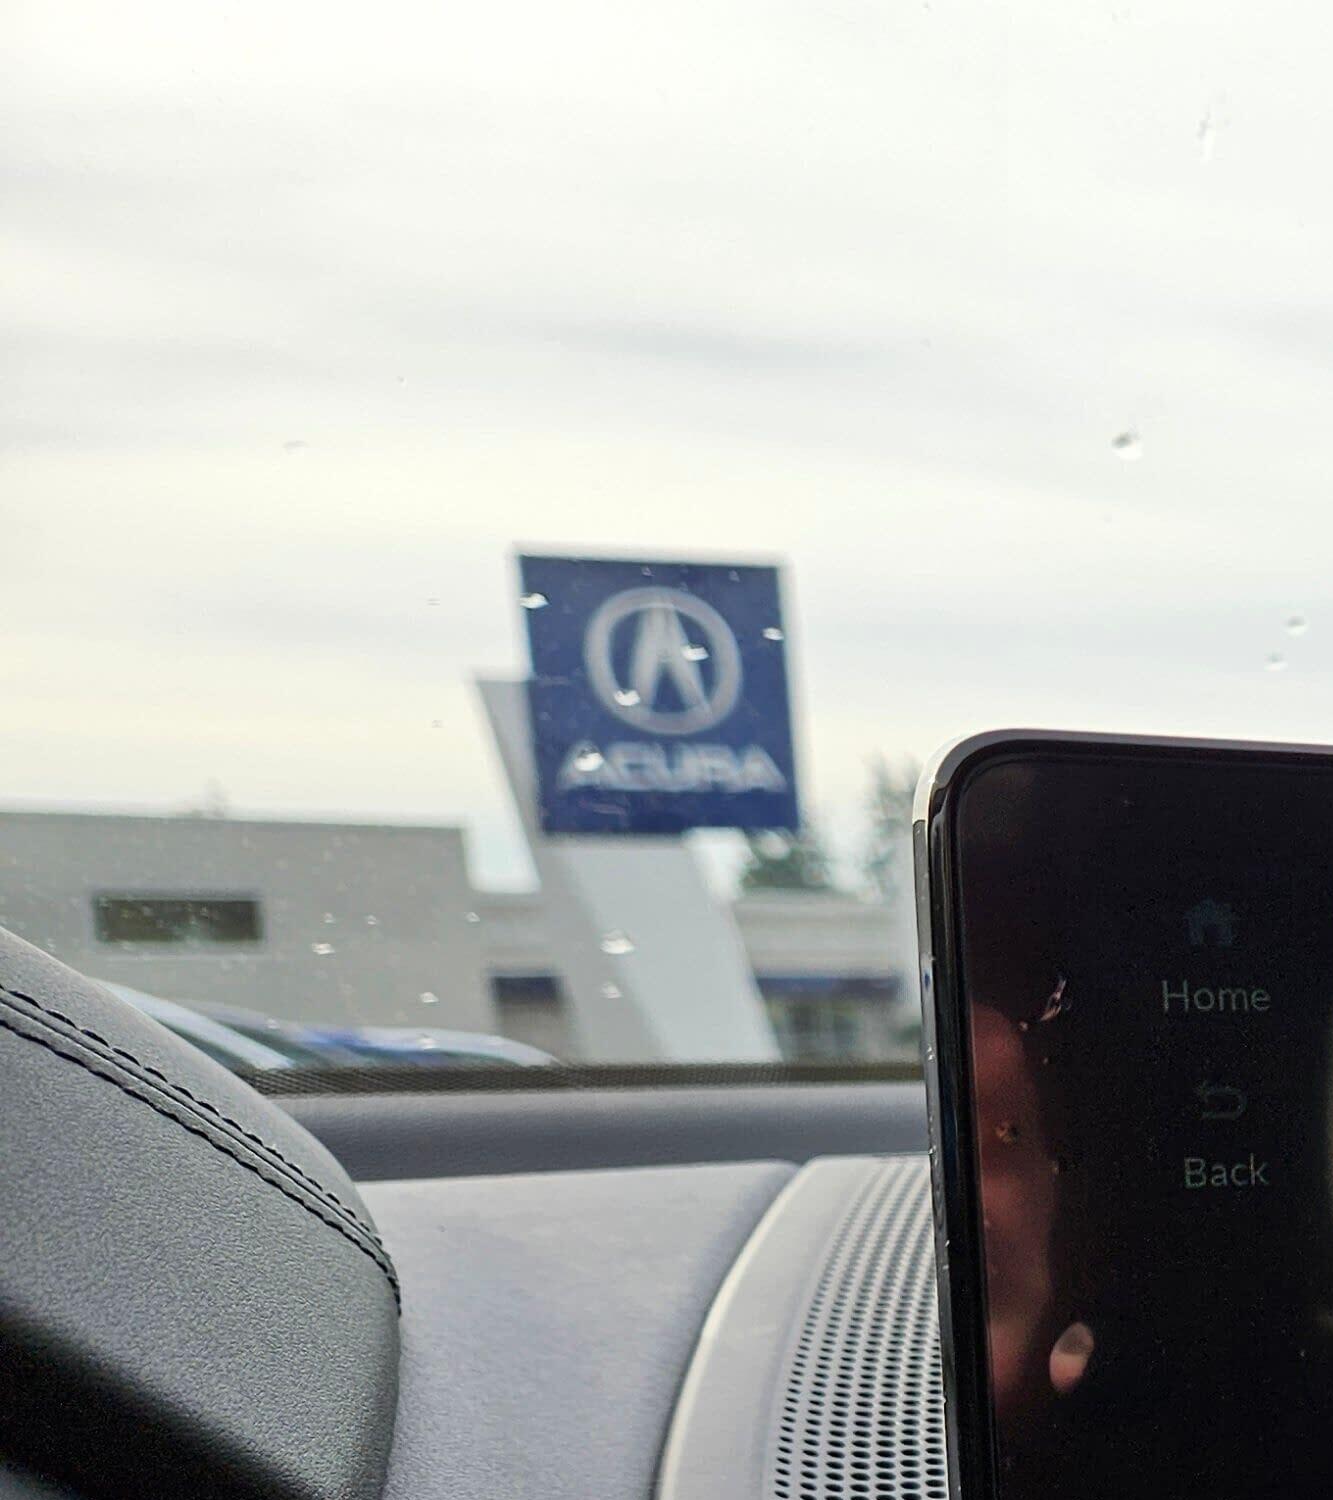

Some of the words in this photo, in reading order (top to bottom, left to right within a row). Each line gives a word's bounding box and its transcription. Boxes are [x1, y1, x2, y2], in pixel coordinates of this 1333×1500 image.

[559, 740, 788, 794] ACURA
[1161, 979, 1272, 1014] Home
[1183, 1152, 1272, 1189] Back
